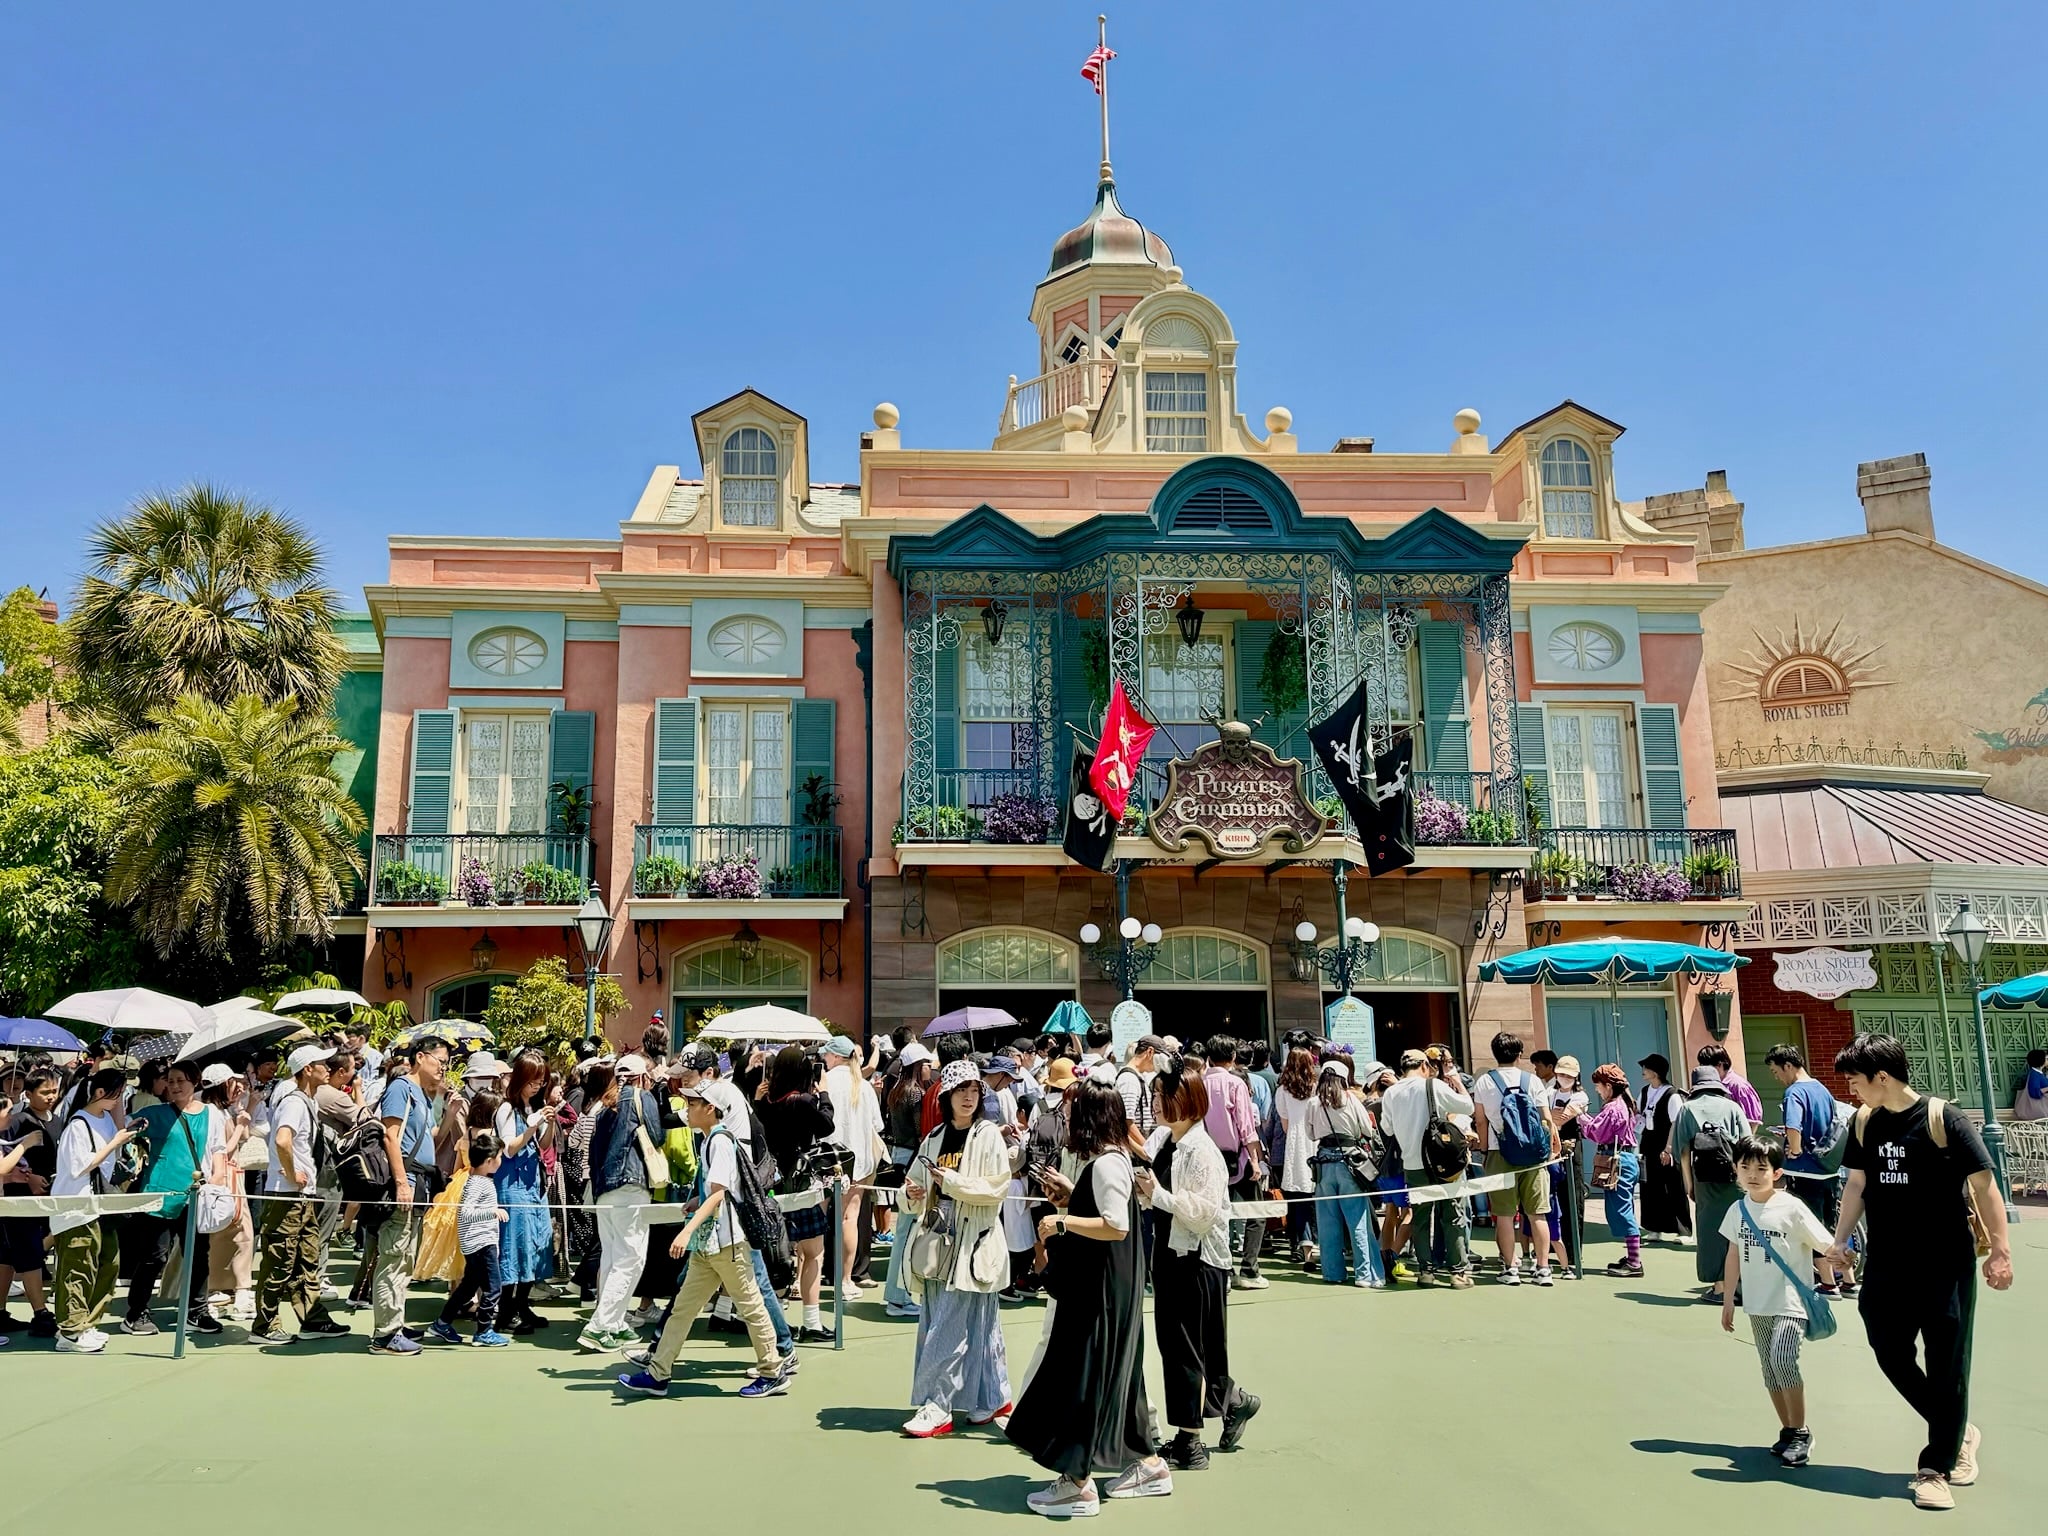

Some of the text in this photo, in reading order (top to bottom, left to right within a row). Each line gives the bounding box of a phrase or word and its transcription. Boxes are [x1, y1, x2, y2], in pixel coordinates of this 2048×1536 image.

[1763, 702, 1850, 723] ROYAL STREET
[1189, 771, 1284, 799] PIRATES
[1236, 792, 1260, 804] of the
[1174, 796, 1304, 823] CARIBBEAN
[1782, 956, 1866, 971] ROYAL STREET
[1796, 969, 1859, 984] VERANDA
[1887, 1159, 1899, 1170] OF
[1879, 1172, 1909, 1184] CEDAR
